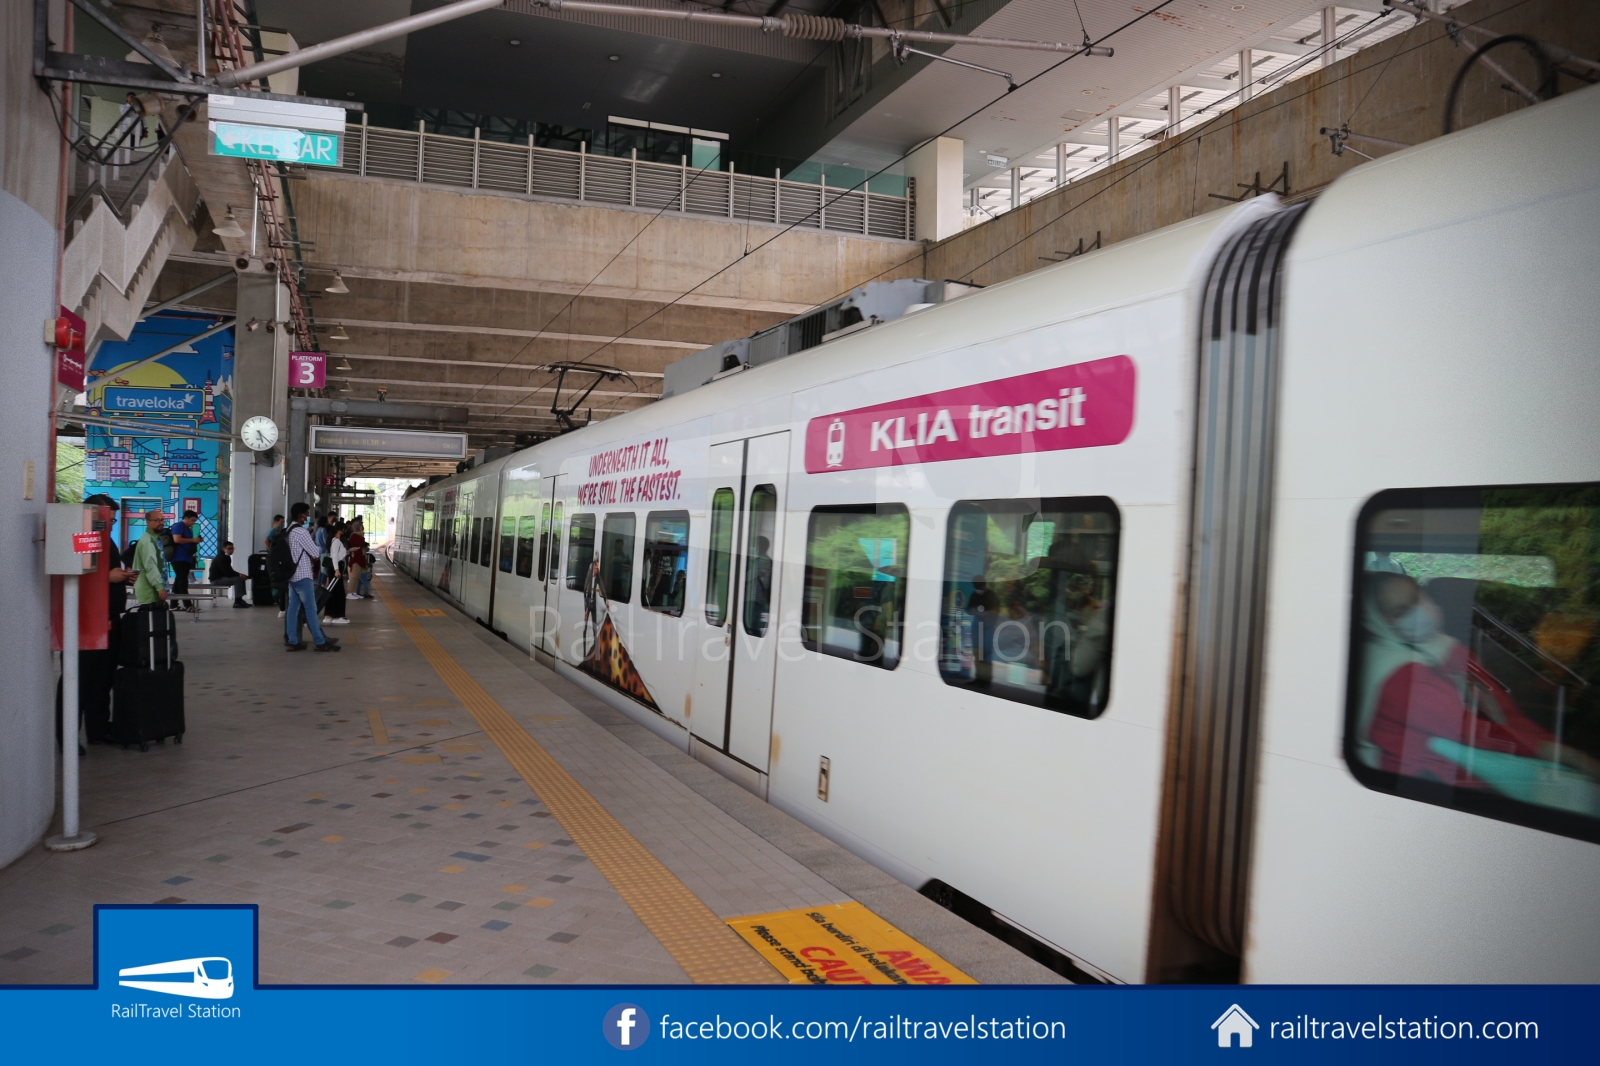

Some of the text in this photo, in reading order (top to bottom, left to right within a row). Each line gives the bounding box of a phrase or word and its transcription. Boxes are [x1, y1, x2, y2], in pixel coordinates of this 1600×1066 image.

[299, 362, 315, 384] 3
[116, 395, 185, 410] traveloka
[869, 387, 1088, 452] KLIA transit
[588, 437, 670, 477] UNDERNEATH IT ALL,
[325, 478, 332, 486] 3
[577, 469, 681, 506] WE'RE STILL THE FASTEST.
[751, 924, 782, 947] Please
[775, 942, 812, 968] stand
[805, 911, 826, 923] Sila
[821, 922, 853, 946] berdiri
[851, 941, 870, 953] di
